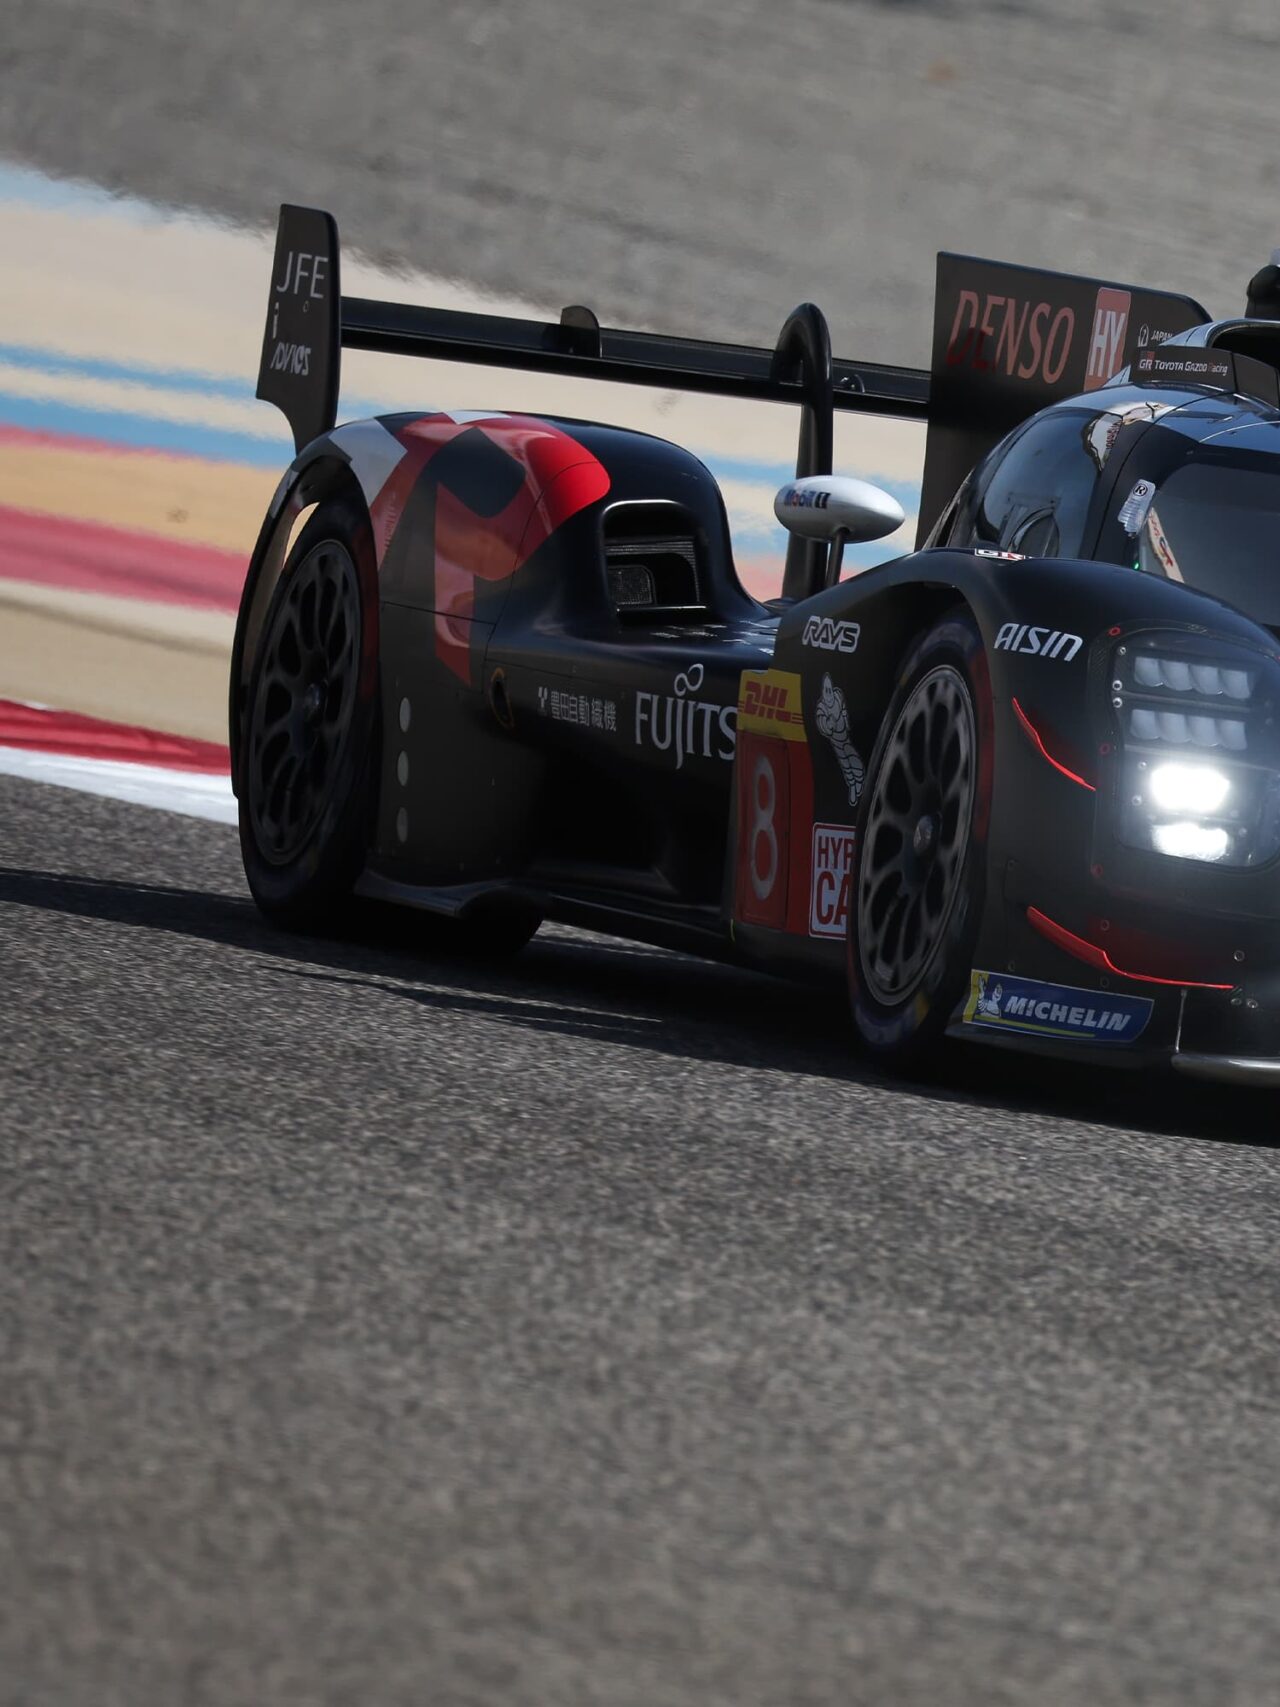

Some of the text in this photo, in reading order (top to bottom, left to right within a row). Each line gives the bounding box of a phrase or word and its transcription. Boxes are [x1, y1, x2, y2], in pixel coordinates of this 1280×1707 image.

[276, 252, 328, 298] JFE
[945, 290, 1075, 384] DENSO
[1088, 308, 1127, 379] HY
[1154, 359, 1185, 372] TOYOTA
[784, 489, 816, 508] Mobil
[802, 616, 861, 653] RAYS
[994, 622, 1083, 662] AISIN
[743, 680, 791, 722] DHL
[634, 690, 738, 770] FUJITS
[751, 753, 778, 900] 8
[817, 835, 856, 871] HYP
[816, 871, 851, 925] CA
[1004, 996, 1132, 1032] MICHELIN
